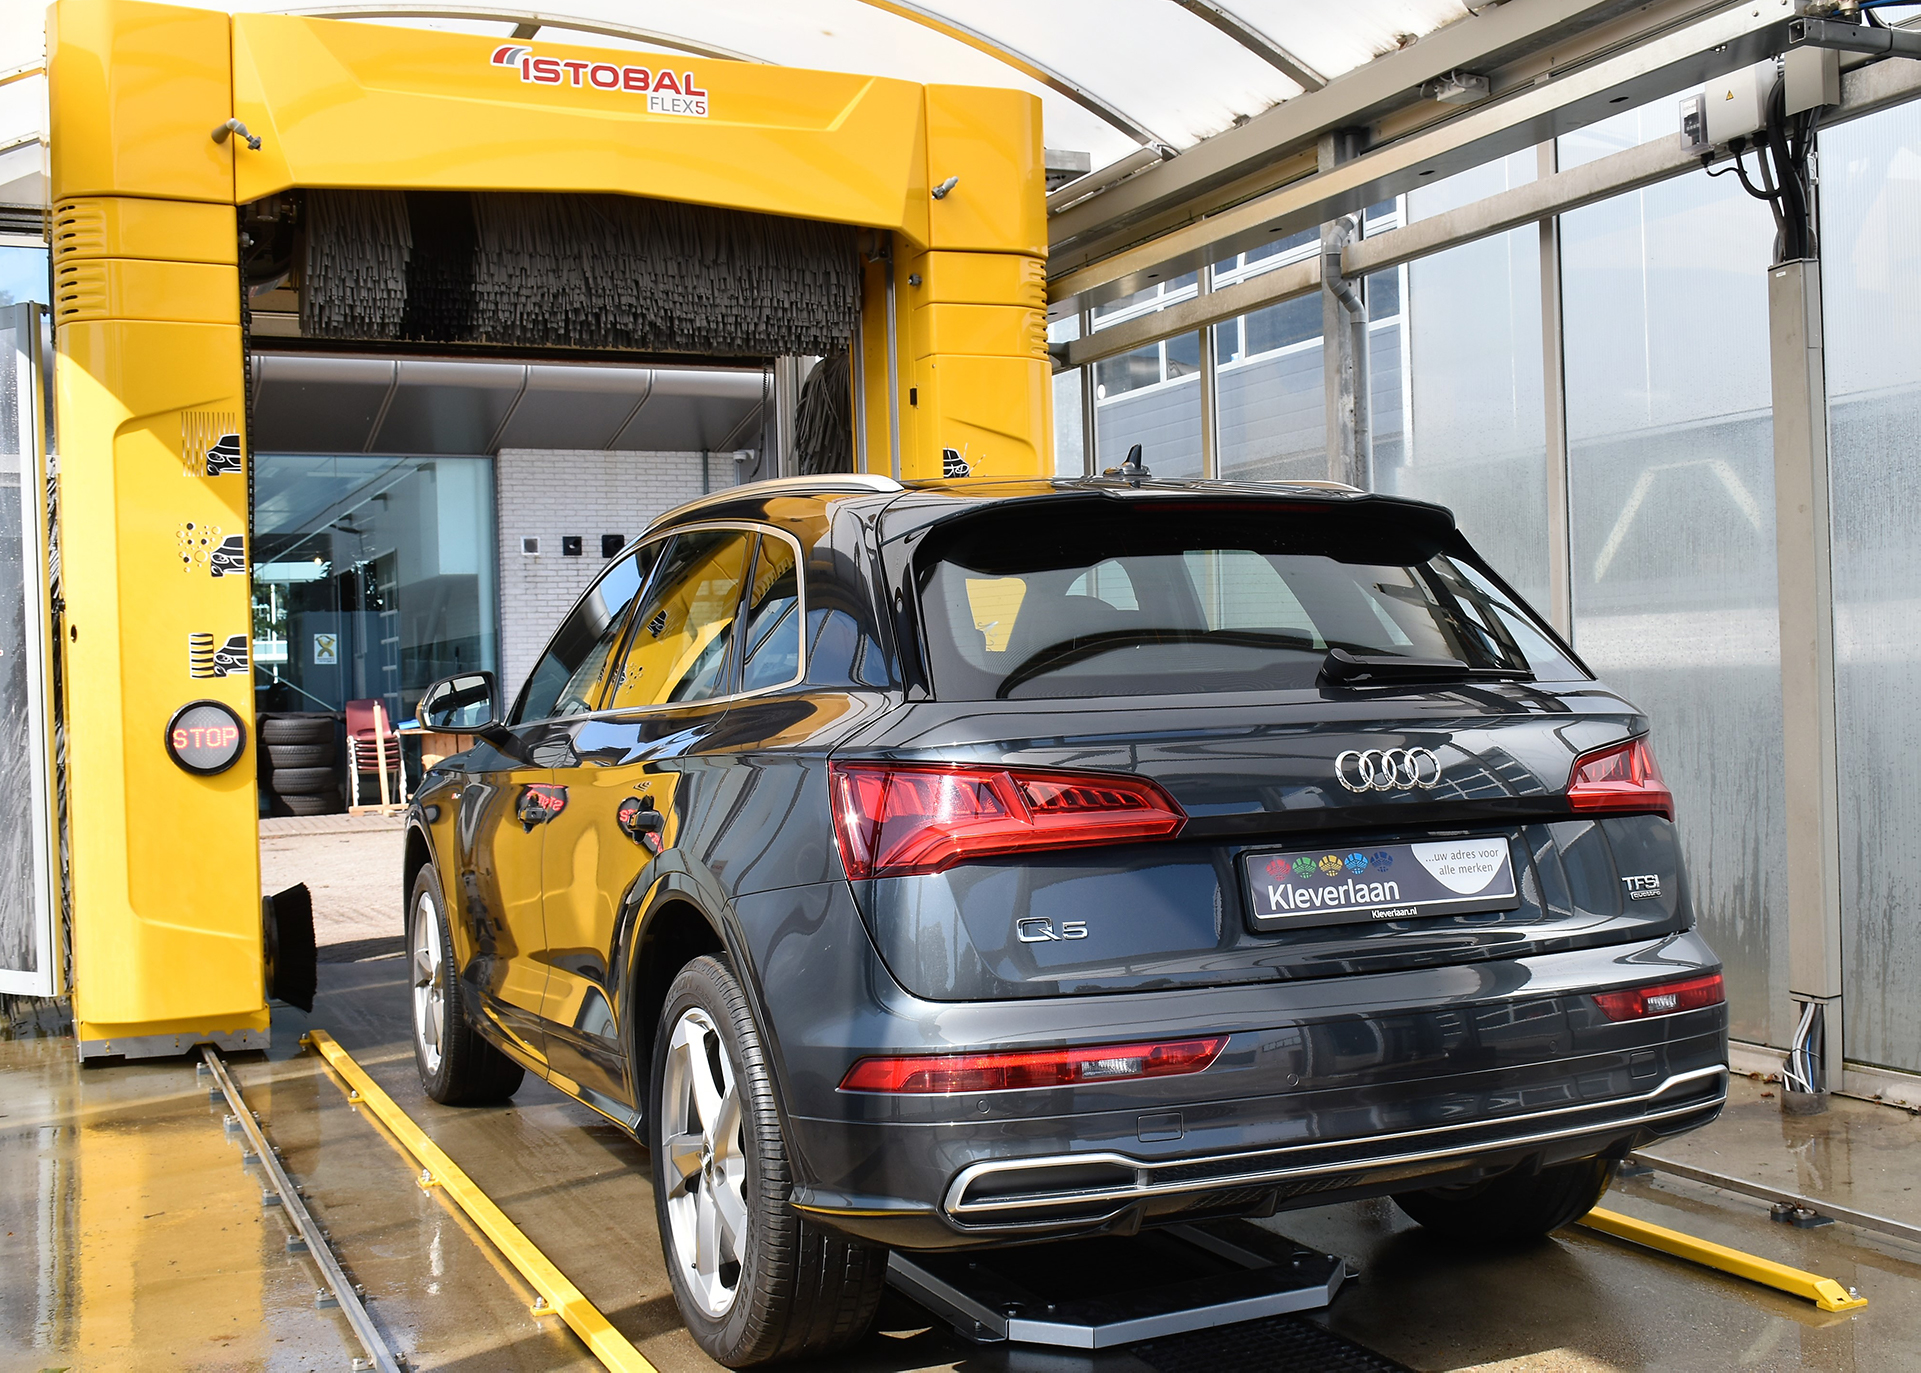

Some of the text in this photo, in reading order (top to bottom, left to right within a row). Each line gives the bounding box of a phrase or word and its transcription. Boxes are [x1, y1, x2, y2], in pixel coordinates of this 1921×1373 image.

[522, 57, 706, 97] ISTOBAL
[650, 96, 706, 115] FLEX5
[172, 727, 238, 750] STOP
[1450, 849, 1476, 861] adres
[1478, 849, 1499, 859] voor
[1439, 863, 1493, 876] alle merken
[1621, 874, 1660, 891] TFSI
[1267, 878, 1400, 911] Kleverlaan
[1371, 907, 1418, 919] Kleverlaan.nl
[1017, 916, 1088, 942] Q5
